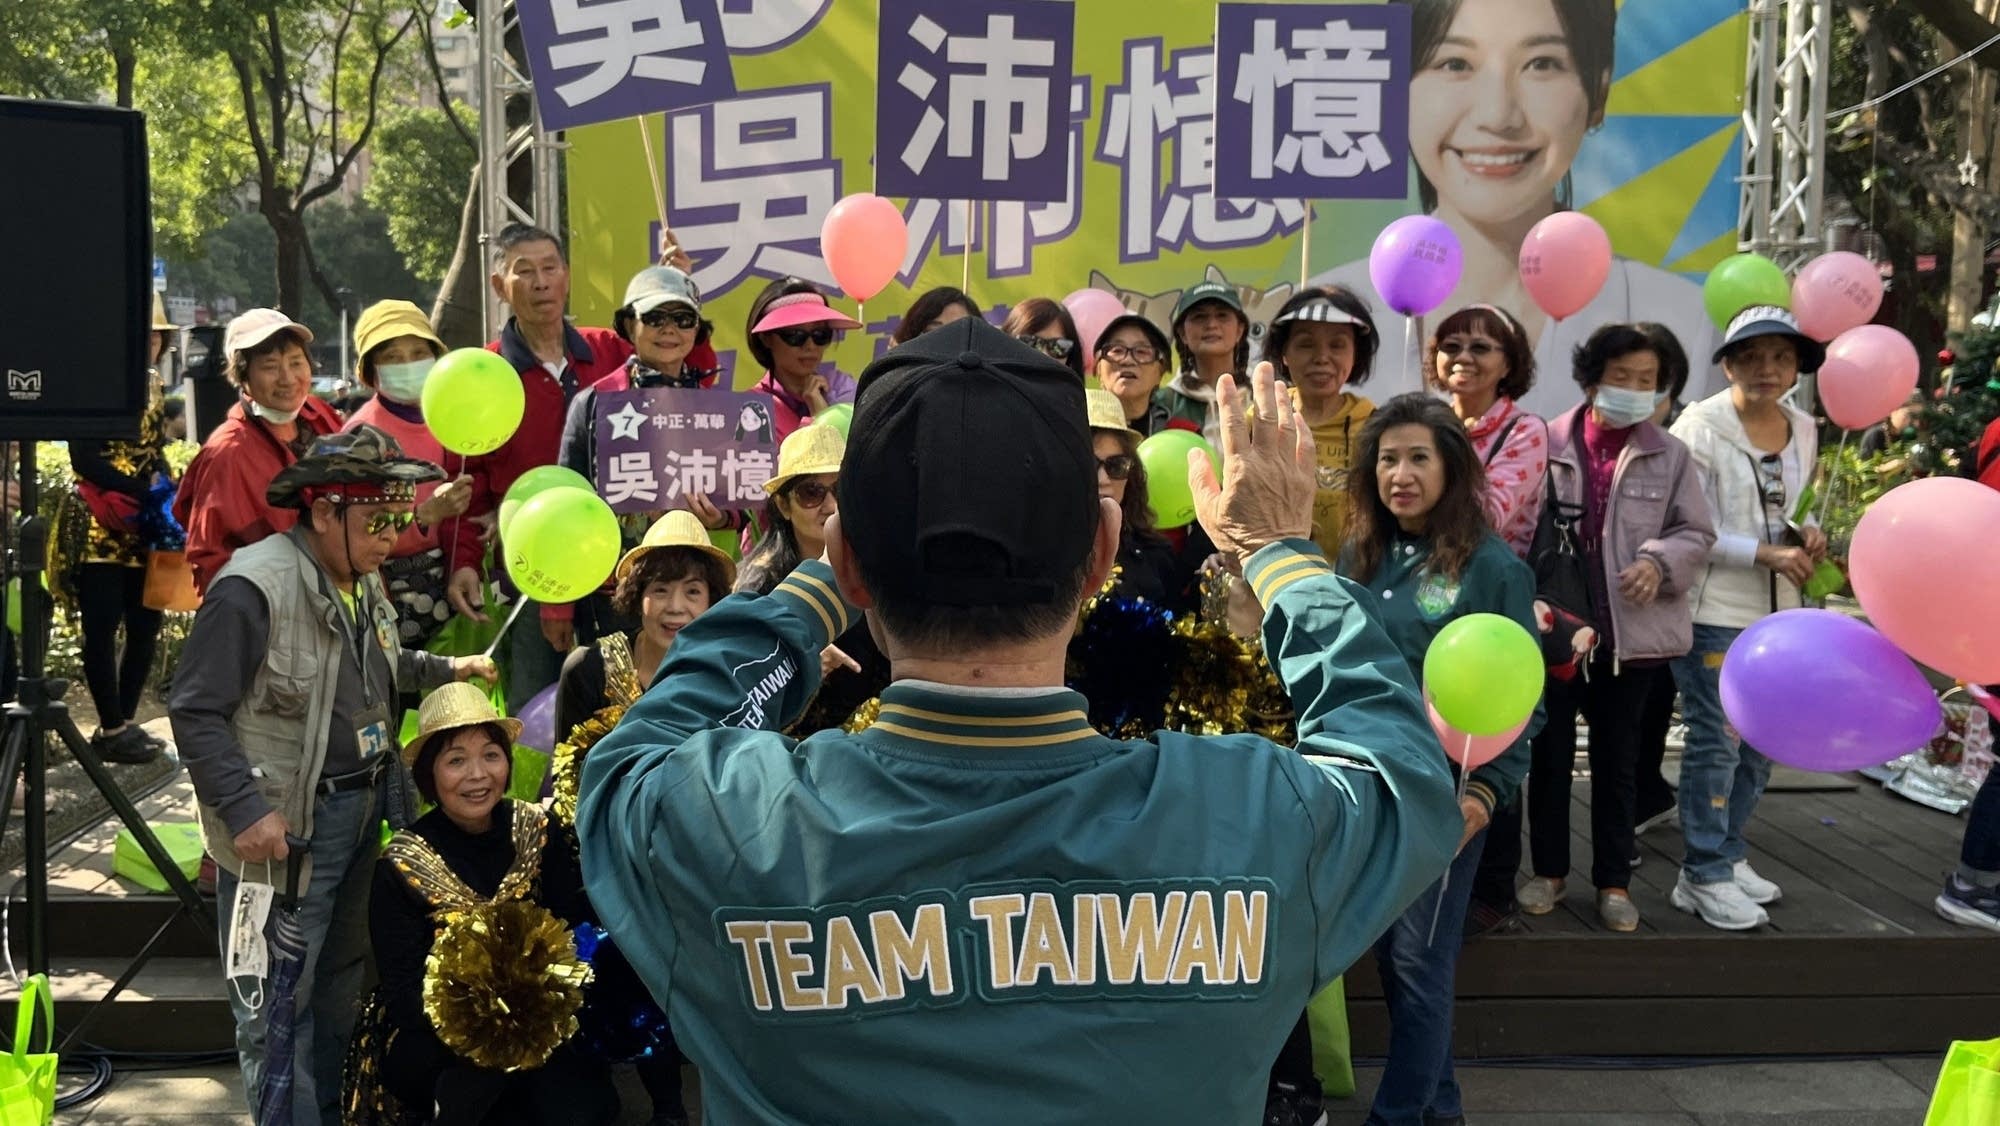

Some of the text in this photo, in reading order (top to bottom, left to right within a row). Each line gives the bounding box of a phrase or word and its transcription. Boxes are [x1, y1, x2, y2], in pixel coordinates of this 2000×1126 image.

[548, 0, 707, 108] 吳
[897, 14, 1055, 181] 沛
[1233, 18, 1391, 180] 憶
[605, 449, 774, 504] 吳沛憶
[622, 415, 634, 431] 7
[724, 891, 1268, 1012] TEAM TAIWAN
